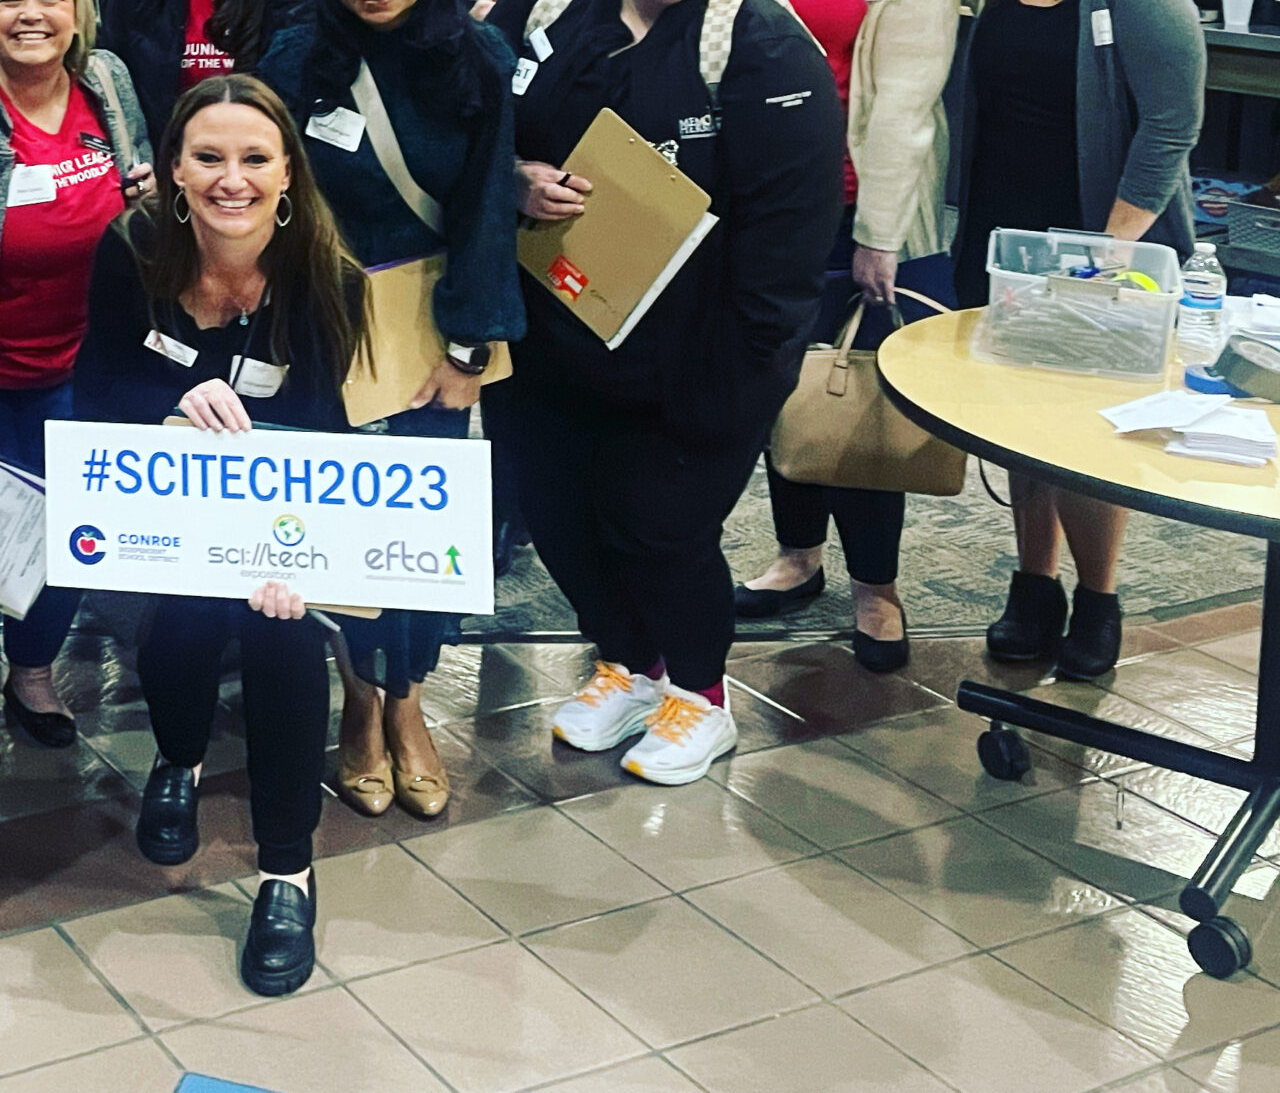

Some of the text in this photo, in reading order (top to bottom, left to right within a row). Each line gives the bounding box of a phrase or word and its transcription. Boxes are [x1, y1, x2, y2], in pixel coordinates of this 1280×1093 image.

[183, 43, 229, 56] JUNI
[197, 58, 221, 69] THE
[82, 448, 449, 511] #SCITECH2023
[118, 533, 182, 547] CONROE
